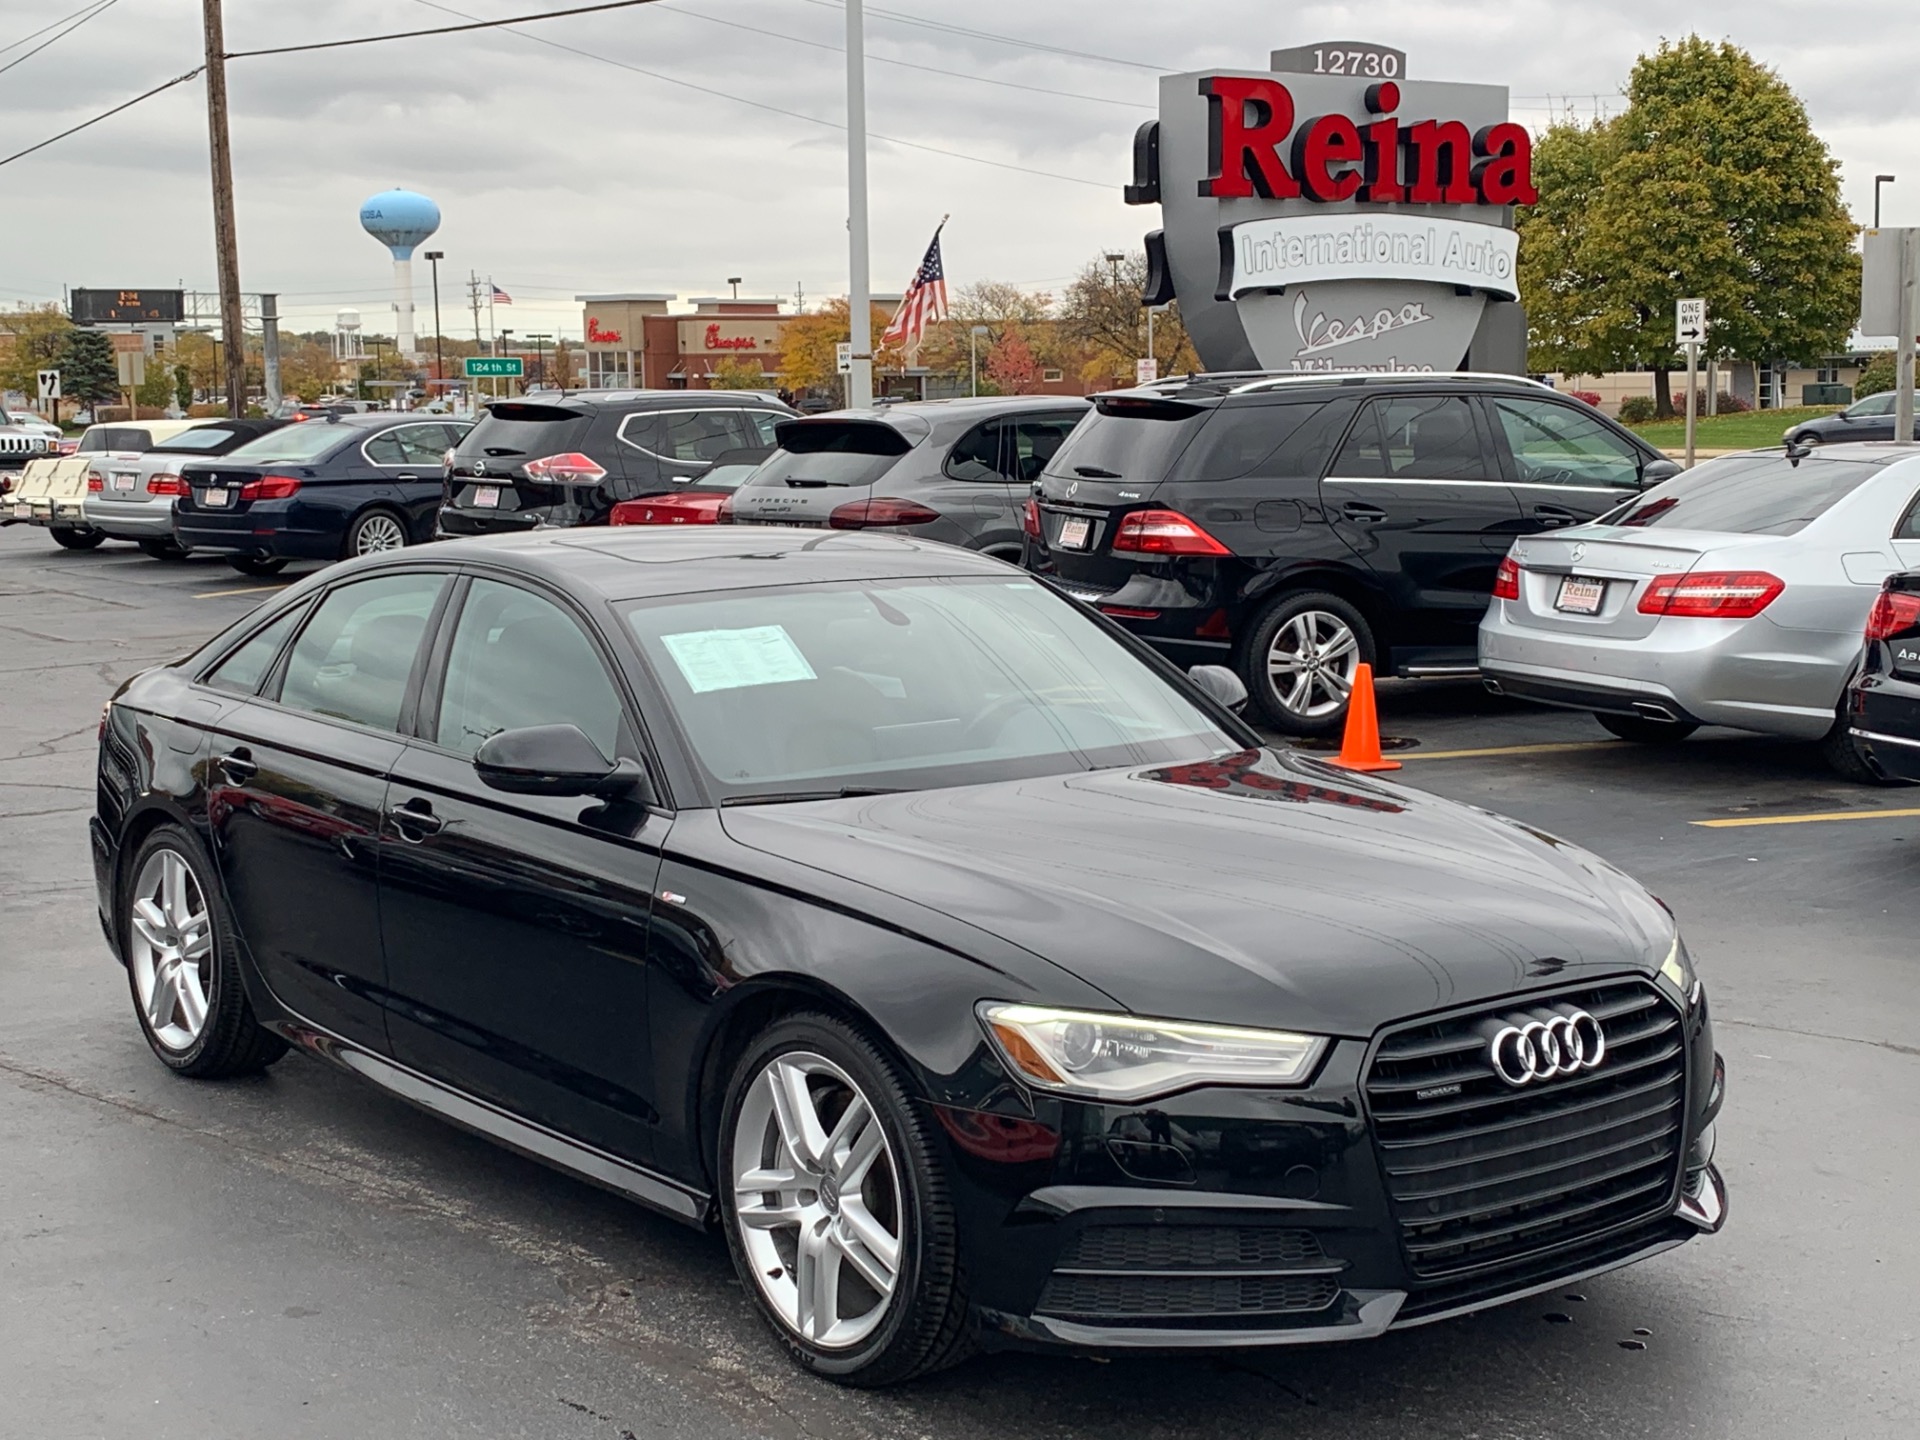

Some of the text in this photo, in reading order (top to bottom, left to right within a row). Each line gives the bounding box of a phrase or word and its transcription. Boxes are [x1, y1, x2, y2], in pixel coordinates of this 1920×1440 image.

[1313, 49, 1398, 78] 12730
[1198, 76, 1539, 206] Reina
[1242, 223, 1511, 279] International Auto
[1681, 302, 1700, 314] ONE
[1293, 290, 1434, 357] Vespa
[1681, 314, 1700, 325] WAY
[506, 362, 516, 372] St
[1565, 582, 1598, 598] Reina
[1898, 648, 1920, 661] A8
